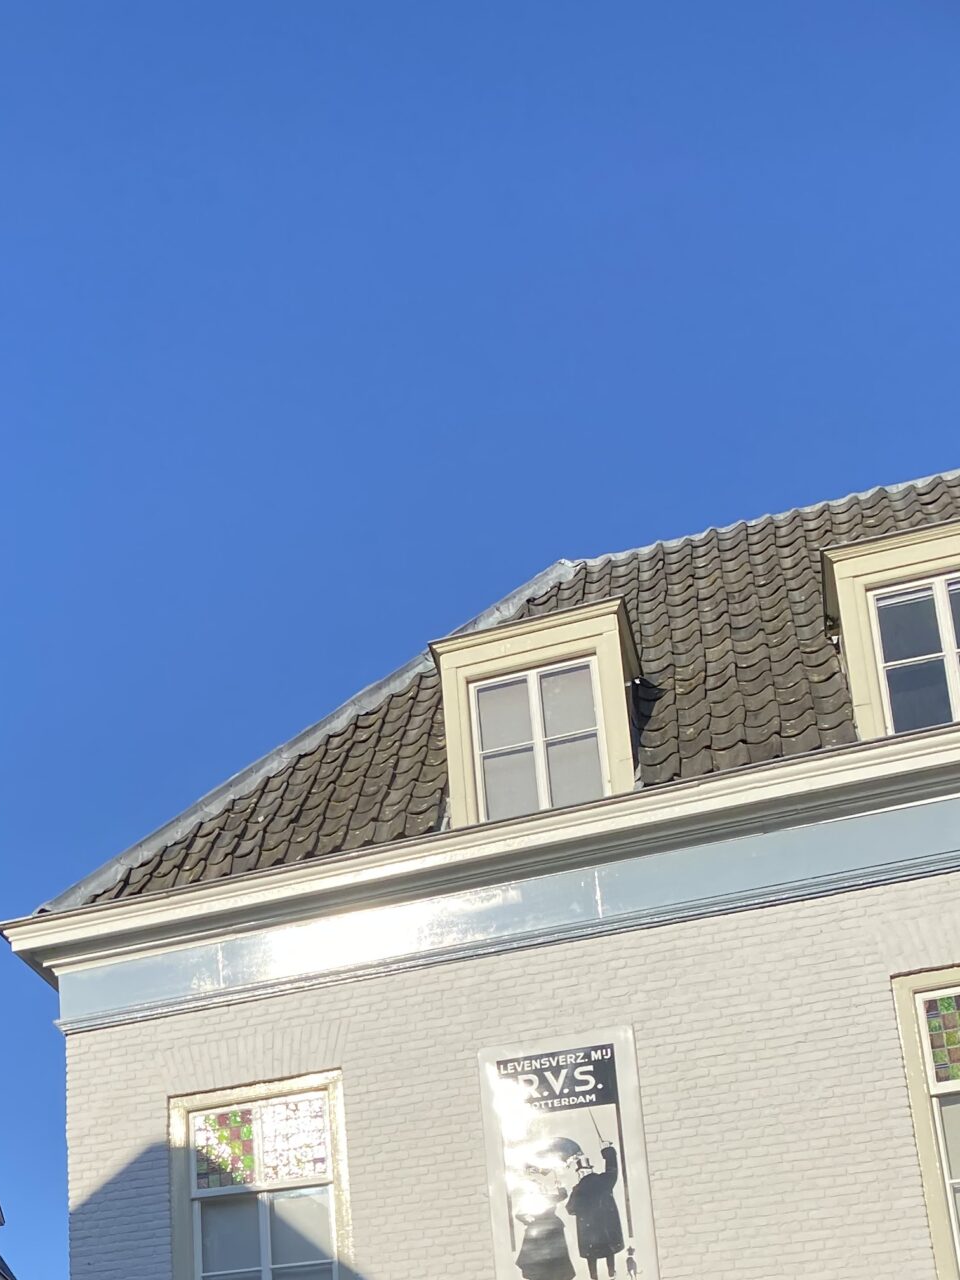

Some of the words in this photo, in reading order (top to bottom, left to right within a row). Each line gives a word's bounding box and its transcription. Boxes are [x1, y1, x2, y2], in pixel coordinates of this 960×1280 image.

[500, 1052, 589, 1075] LEVENSVERZ.
[518, 1065, 604, 1098] R.V.S.
[524, 1094, 596, 1109] OTTERDAM
